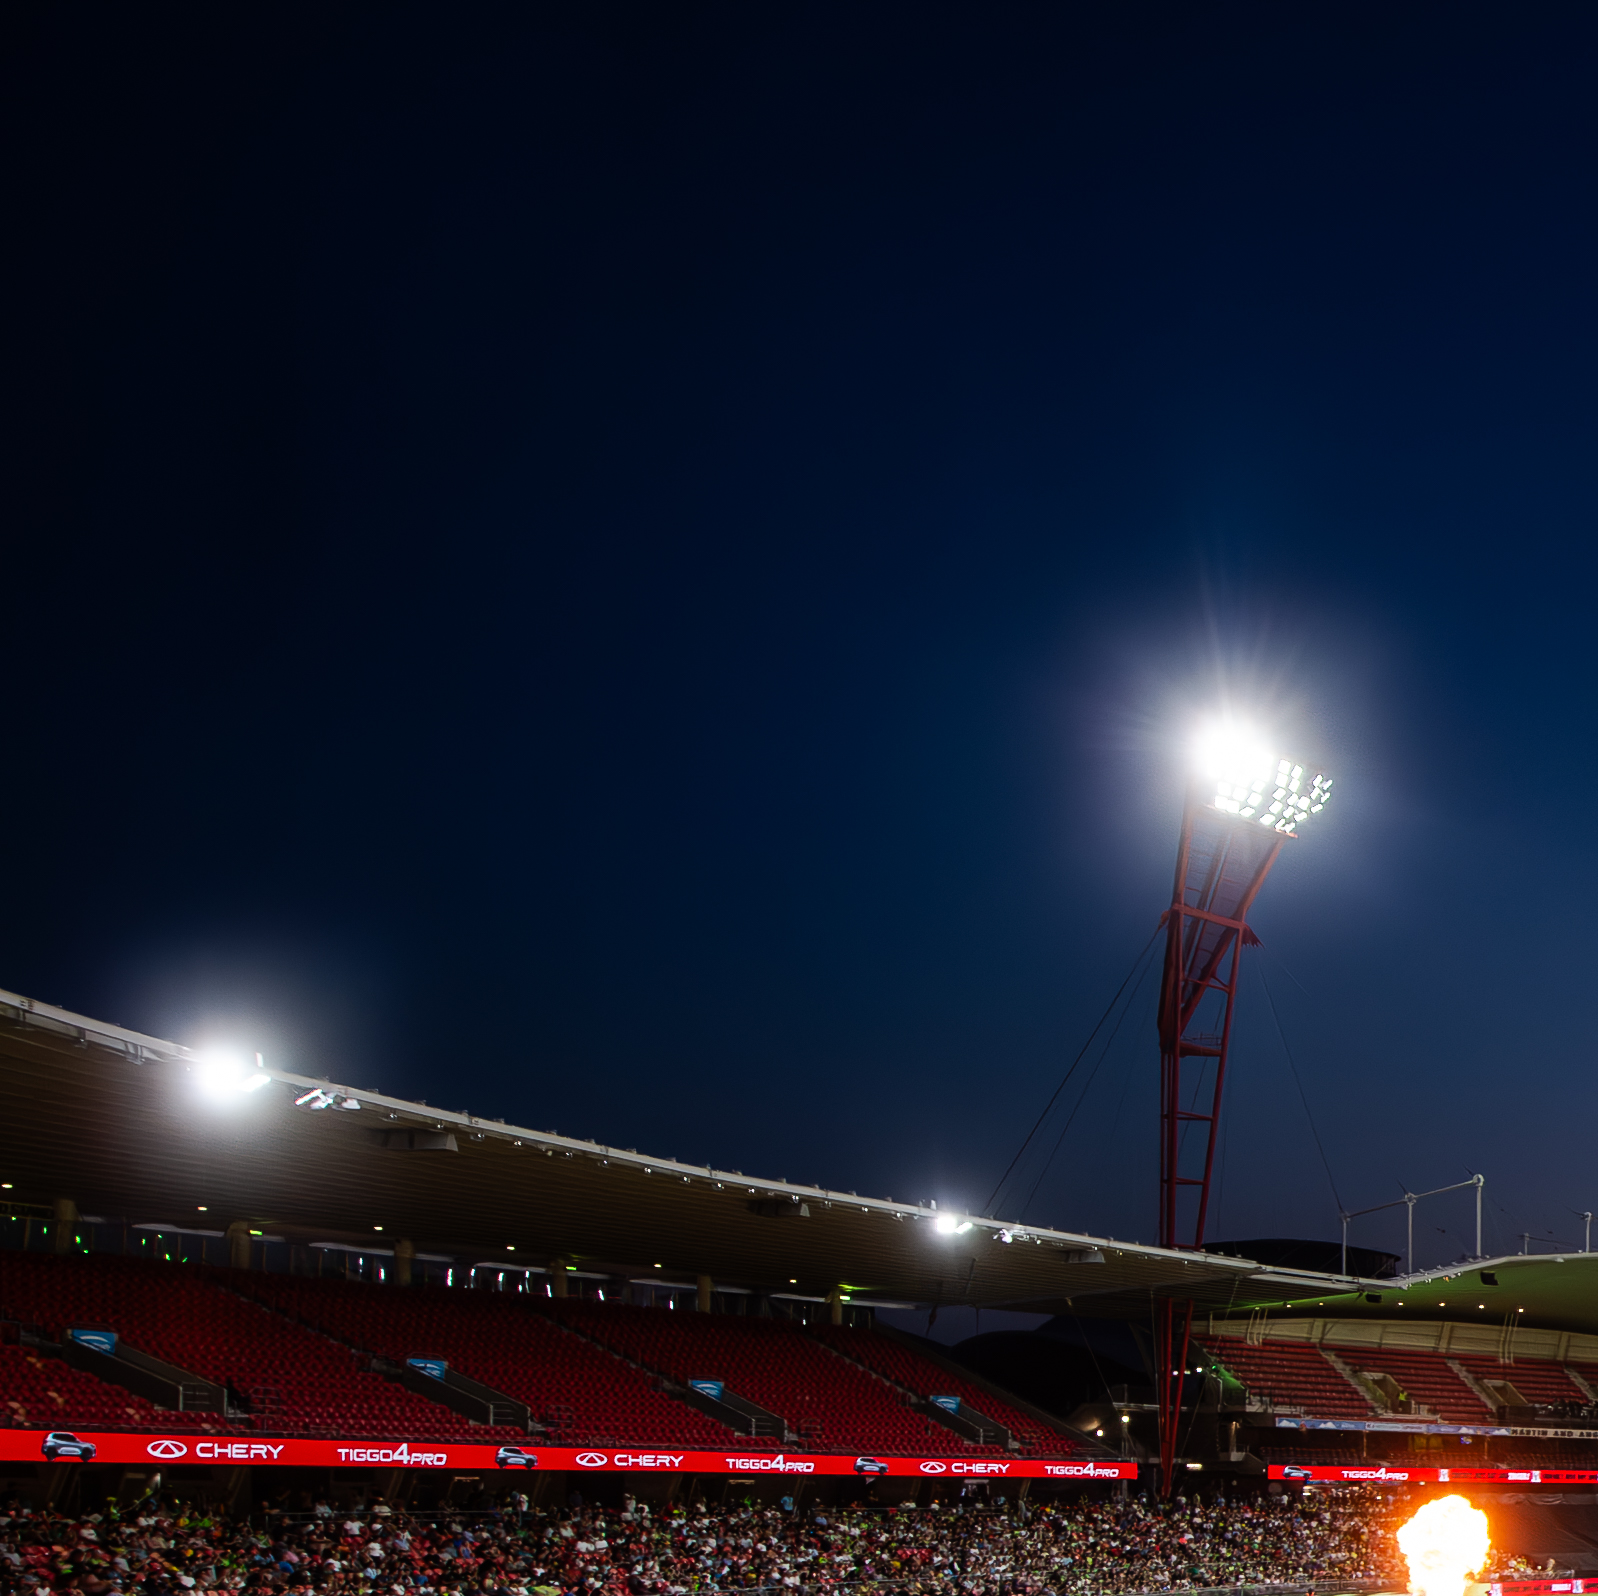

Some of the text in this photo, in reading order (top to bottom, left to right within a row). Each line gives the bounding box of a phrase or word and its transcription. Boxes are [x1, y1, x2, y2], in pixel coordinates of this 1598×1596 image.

[196, 1443, 284, 1459] CHERY
[614, 1454, 683, 1466] CHERY
[952, 1463, 1009, 1473] CHERY
